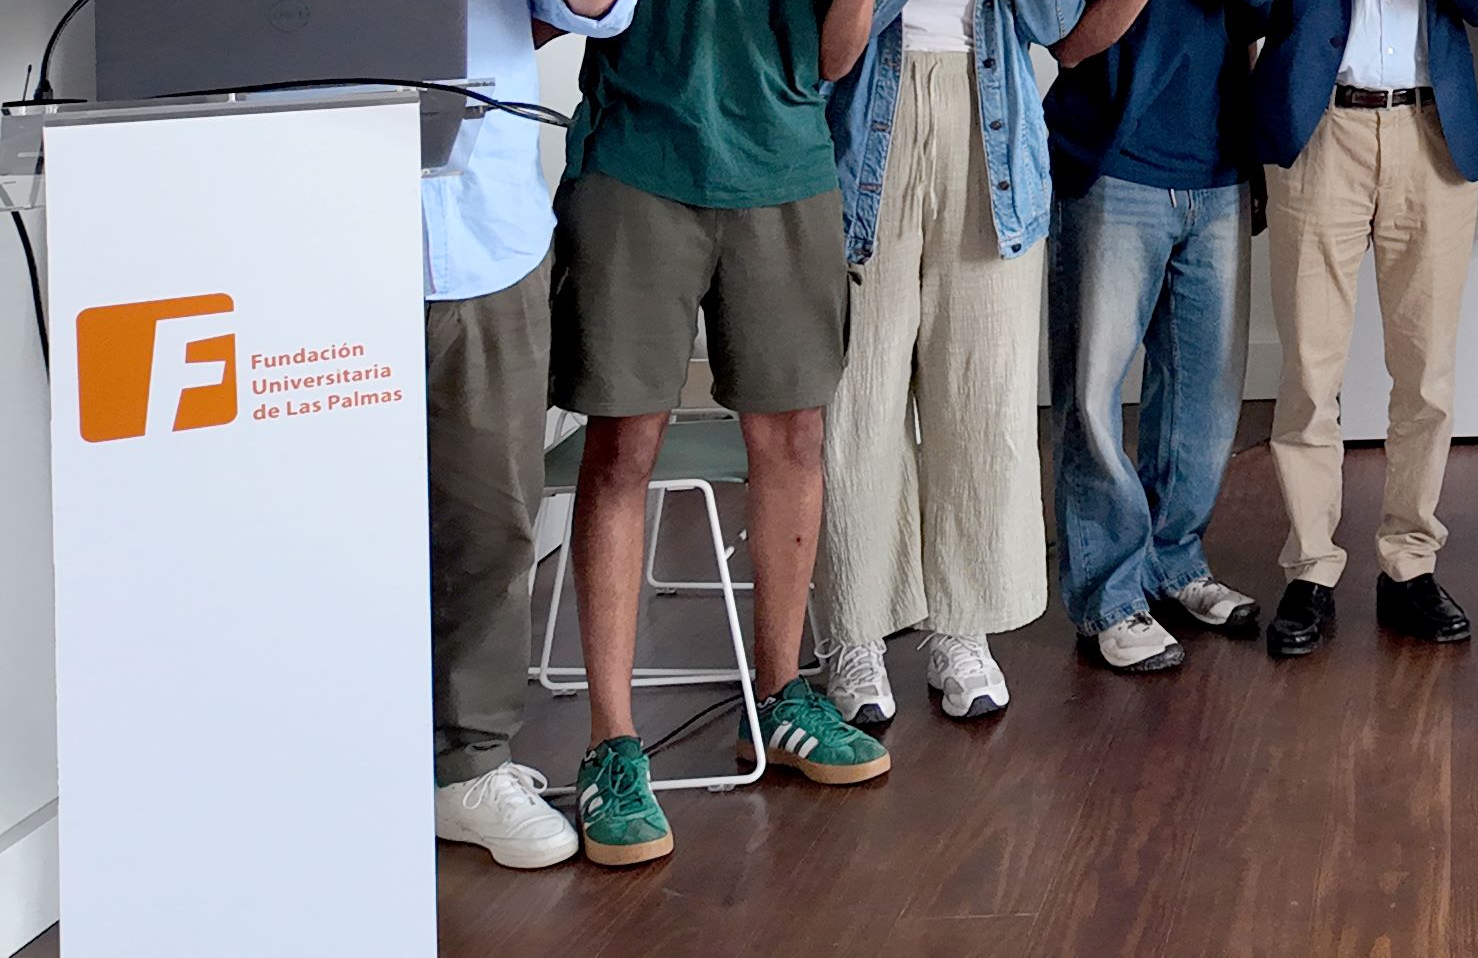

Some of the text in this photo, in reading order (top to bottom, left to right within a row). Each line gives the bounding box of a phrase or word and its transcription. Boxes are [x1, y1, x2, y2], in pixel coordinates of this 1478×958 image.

[251, 342, 365, 370] Fundación
[252, 363, 392, 395] Universitaria
[252, 389, 403, 421] de Las Palmas
